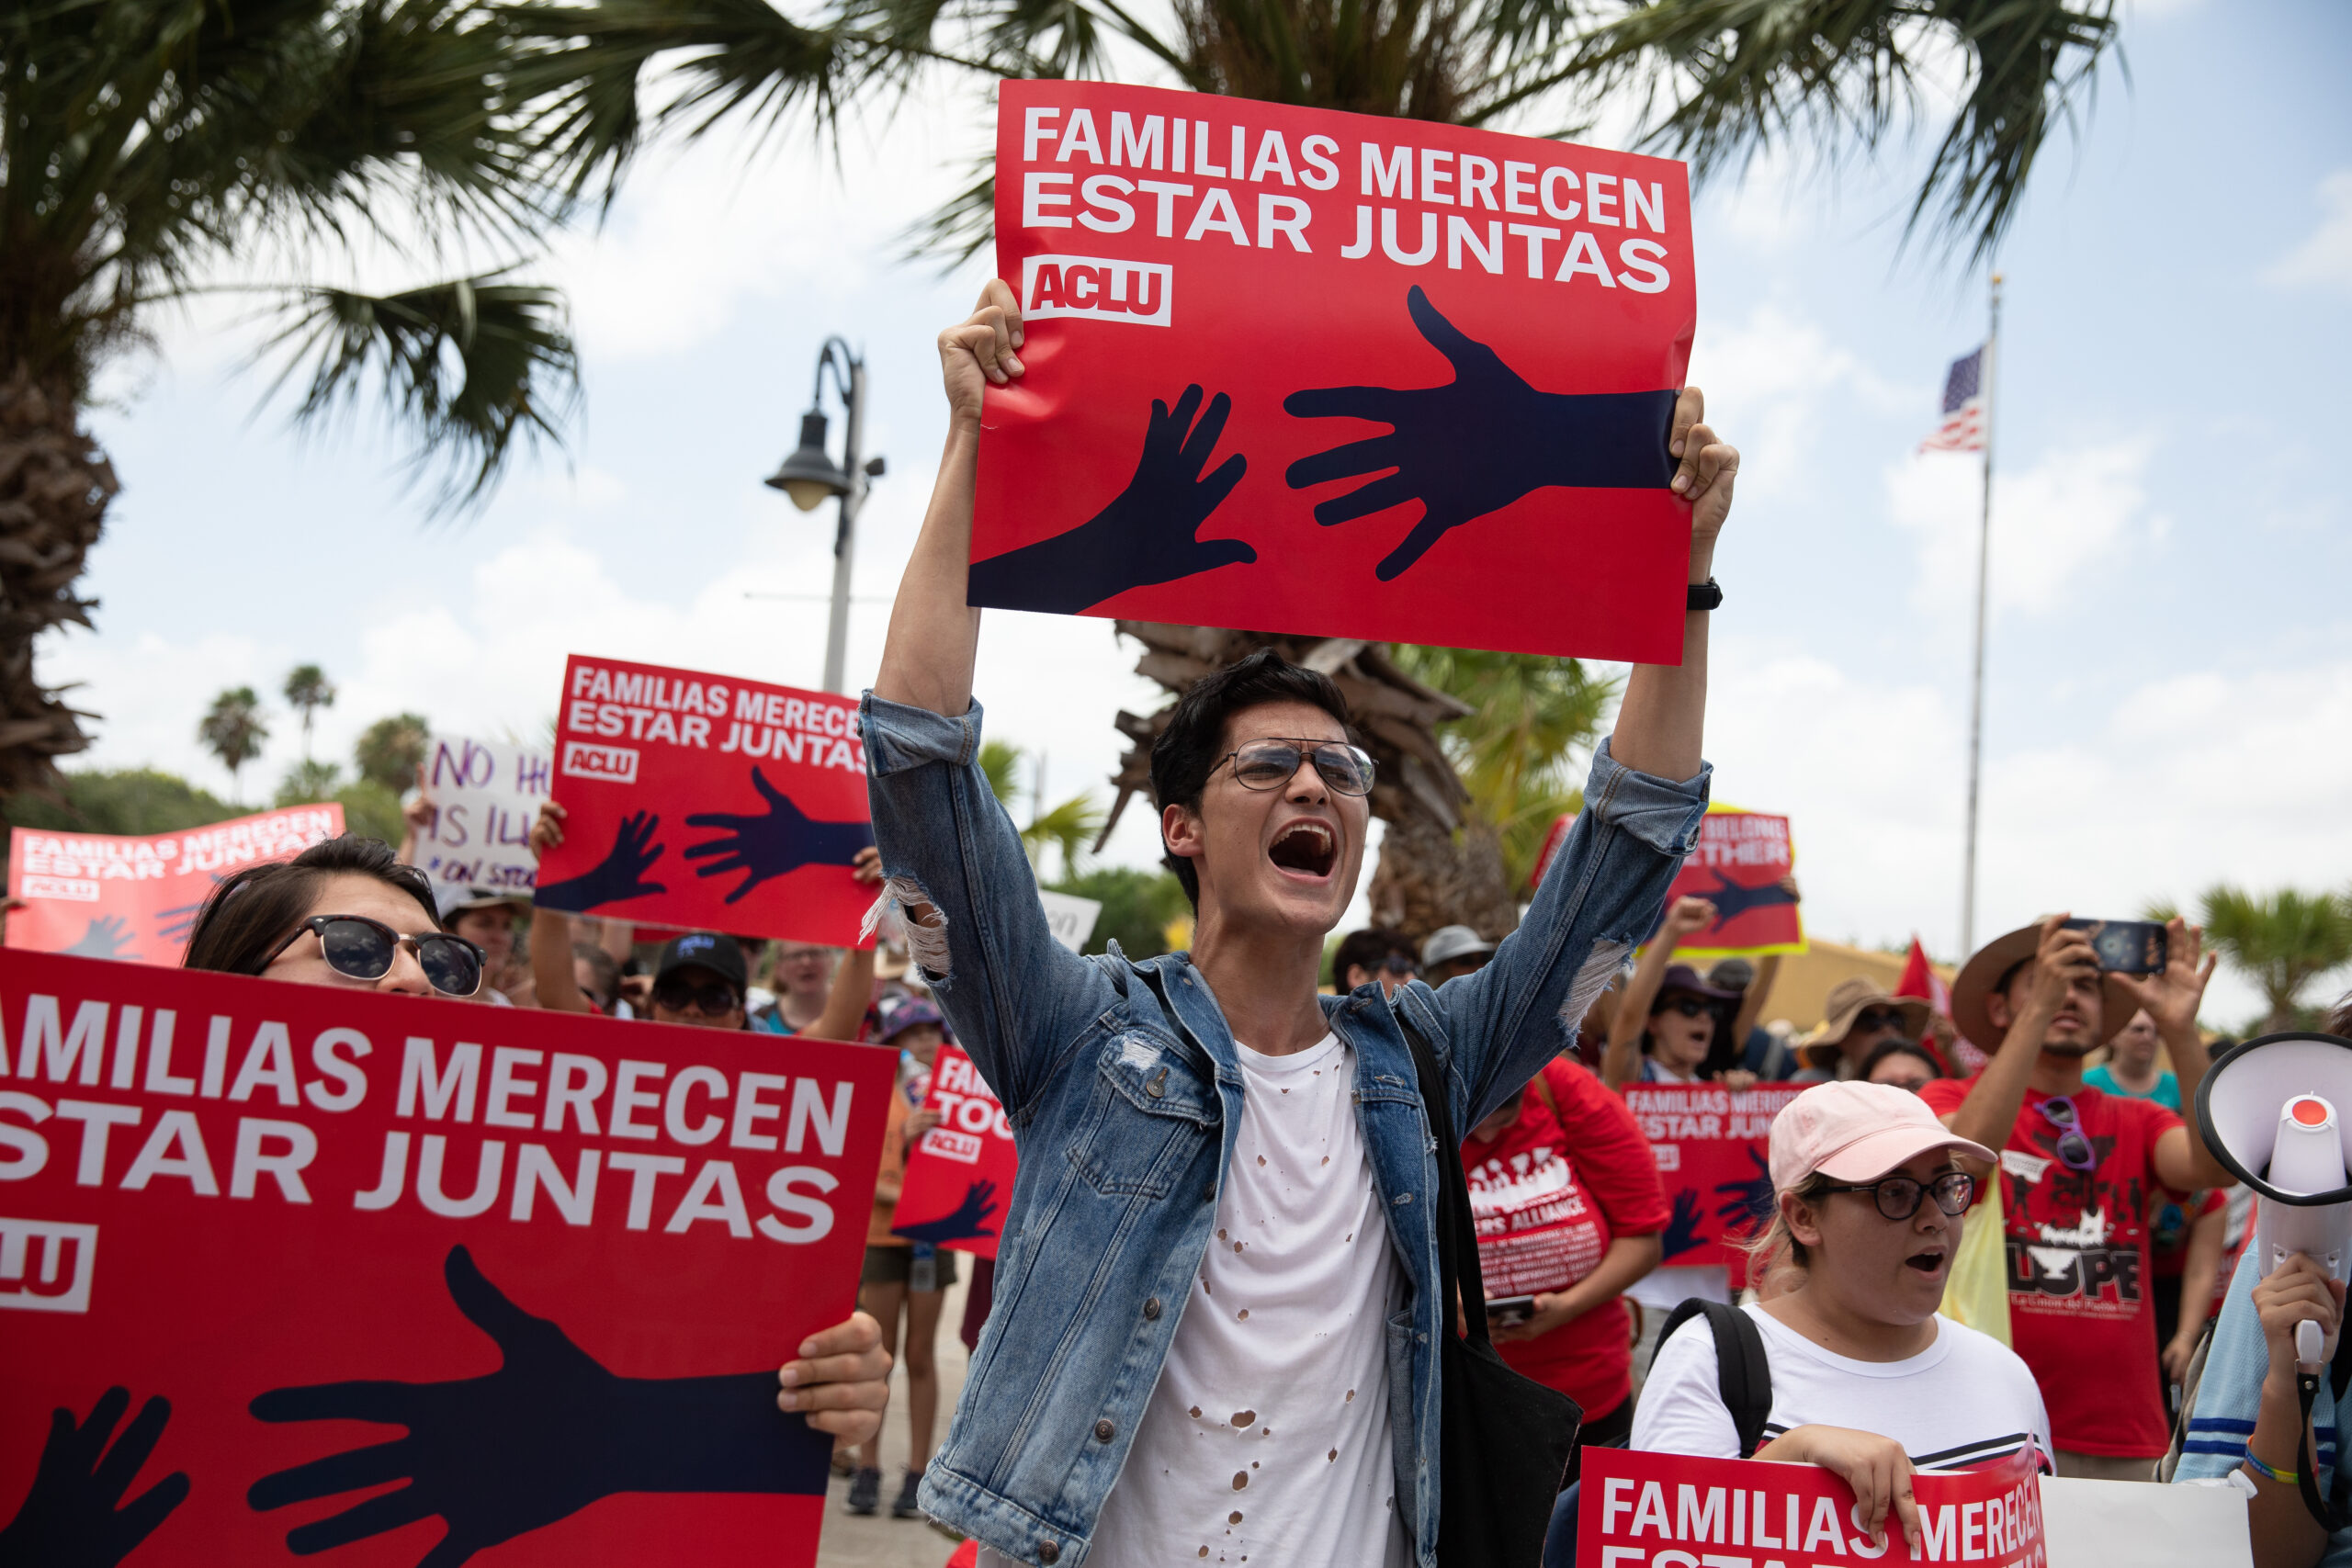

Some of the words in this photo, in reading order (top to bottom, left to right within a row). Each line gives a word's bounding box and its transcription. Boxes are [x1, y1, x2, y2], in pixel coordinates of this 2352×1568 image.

[1023, 107, 1340, 191] FAMILIAS
[1361, 142, 1667, 234] MERECEN
[1022, 172, 1313, 254] ESTAR
[1340, 205, 1672, 294] JUNTAS
[1030, 263, 1163, 316] ACLU
[571, 666, 729, 717] FAMILIAS
[568, 701, 711, 749] ESTAR
[432, 739, 495, 788] NO
[570, 749, 632, 776] ACLU
[22, 835, 178, 863] FAMILIAS
[184, 810, 333, 853] MERECEN
[23, 856, 165, 879] ESTAR
[0, 992, 373, 1113] MILIAS
[396, 1036, 854, 1157] MERECEN
[1626, 1089, 1728, 1115] FAMILIAS
[354, 1130, 841, 1245] JUNTAS
[1510, 1195, 1587, 1233] ALLIANCE
[1602, 1477, 1889, 1560] FAMILIAS
[1910, 1468, 2041, 1562] MERECEN
